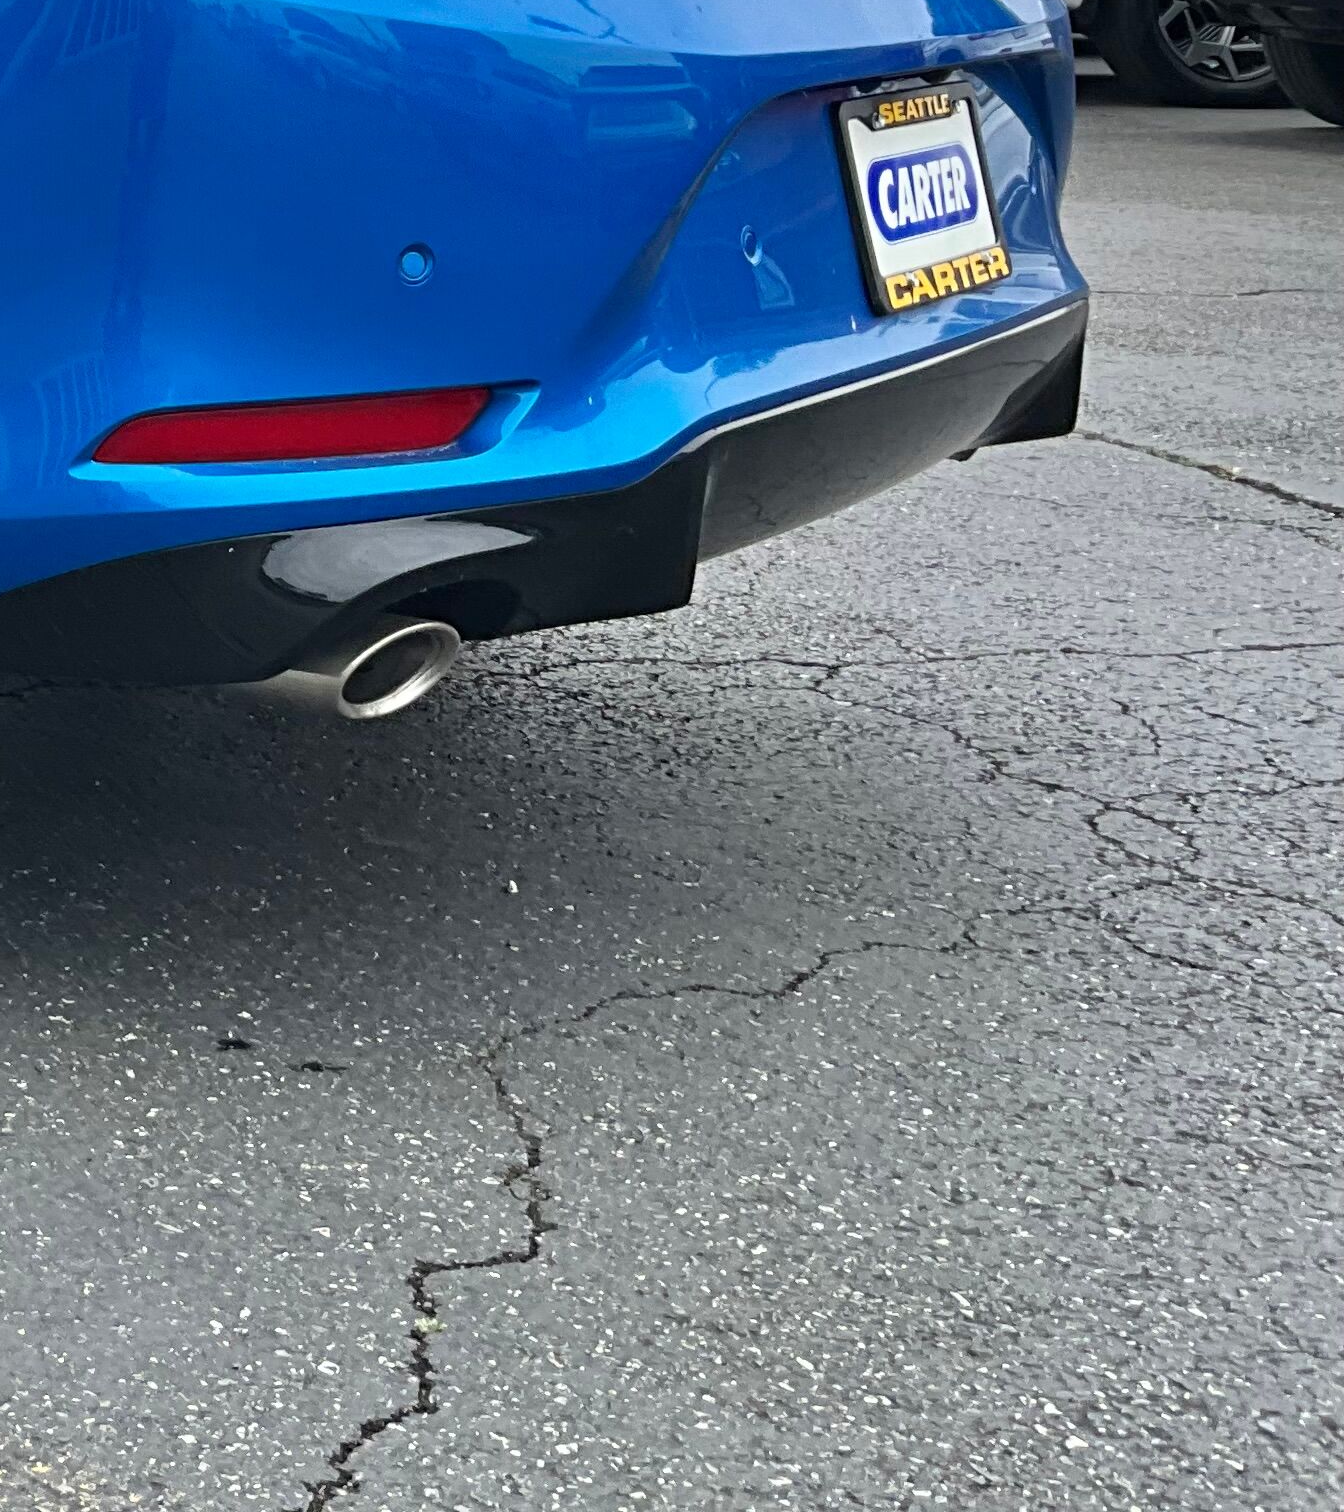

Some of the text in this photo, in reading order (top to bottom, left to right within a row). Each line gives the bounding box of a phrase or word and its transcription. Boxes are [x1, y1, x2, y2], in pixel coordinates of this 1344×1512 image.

[878, 93, 951, 125] SEATTLE
[878, 155, 971, 230] CARTER
[885, 246, 1010, 310] CARTER
